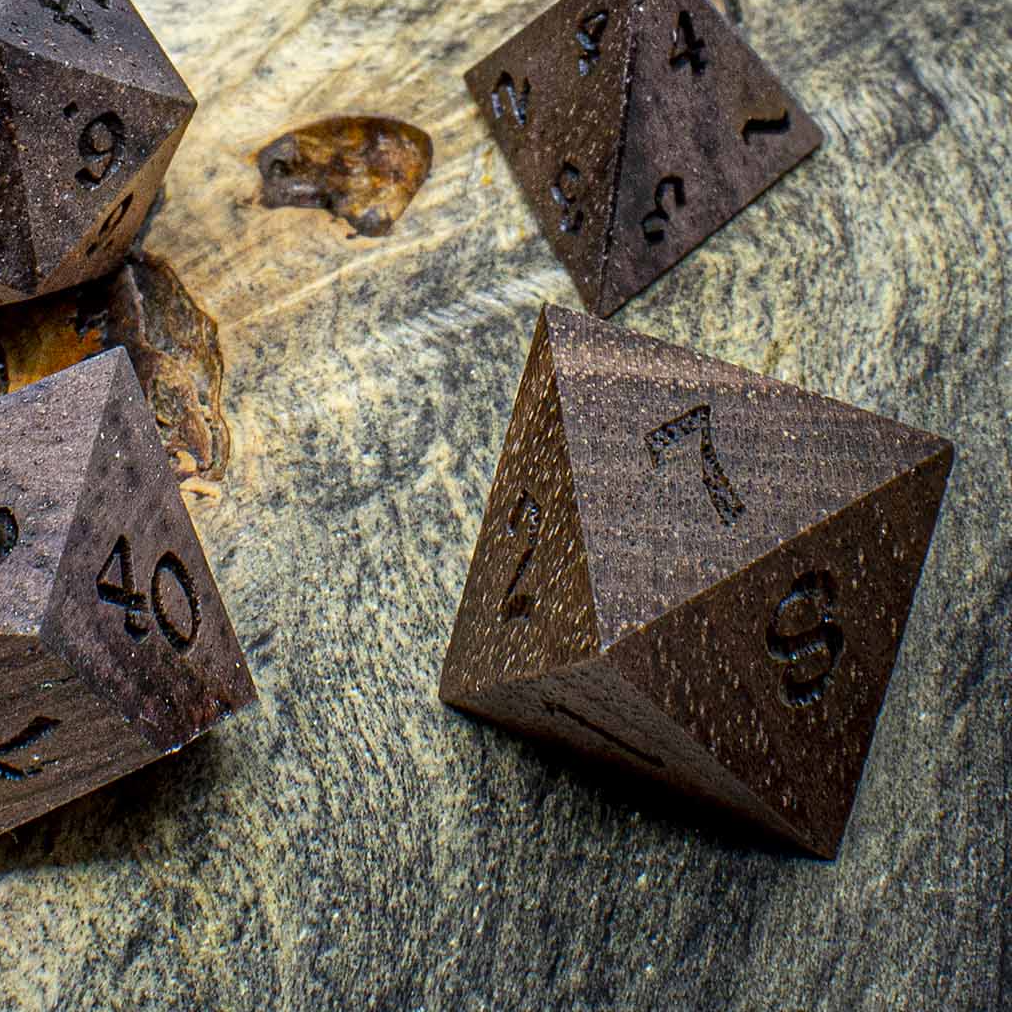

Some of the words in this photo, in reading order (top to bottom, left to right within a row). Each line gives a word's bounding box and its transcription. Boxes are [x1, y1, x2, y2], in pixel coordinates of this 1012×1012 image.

[669, 10, 706, 75] 4
[740, 109, 791, 145] 1
[642, 177, 687, 245] 3
[644, 405, 745, 528] 7
[96, 534, 202, 650] 40
[766, 568, 845, 708] 8
